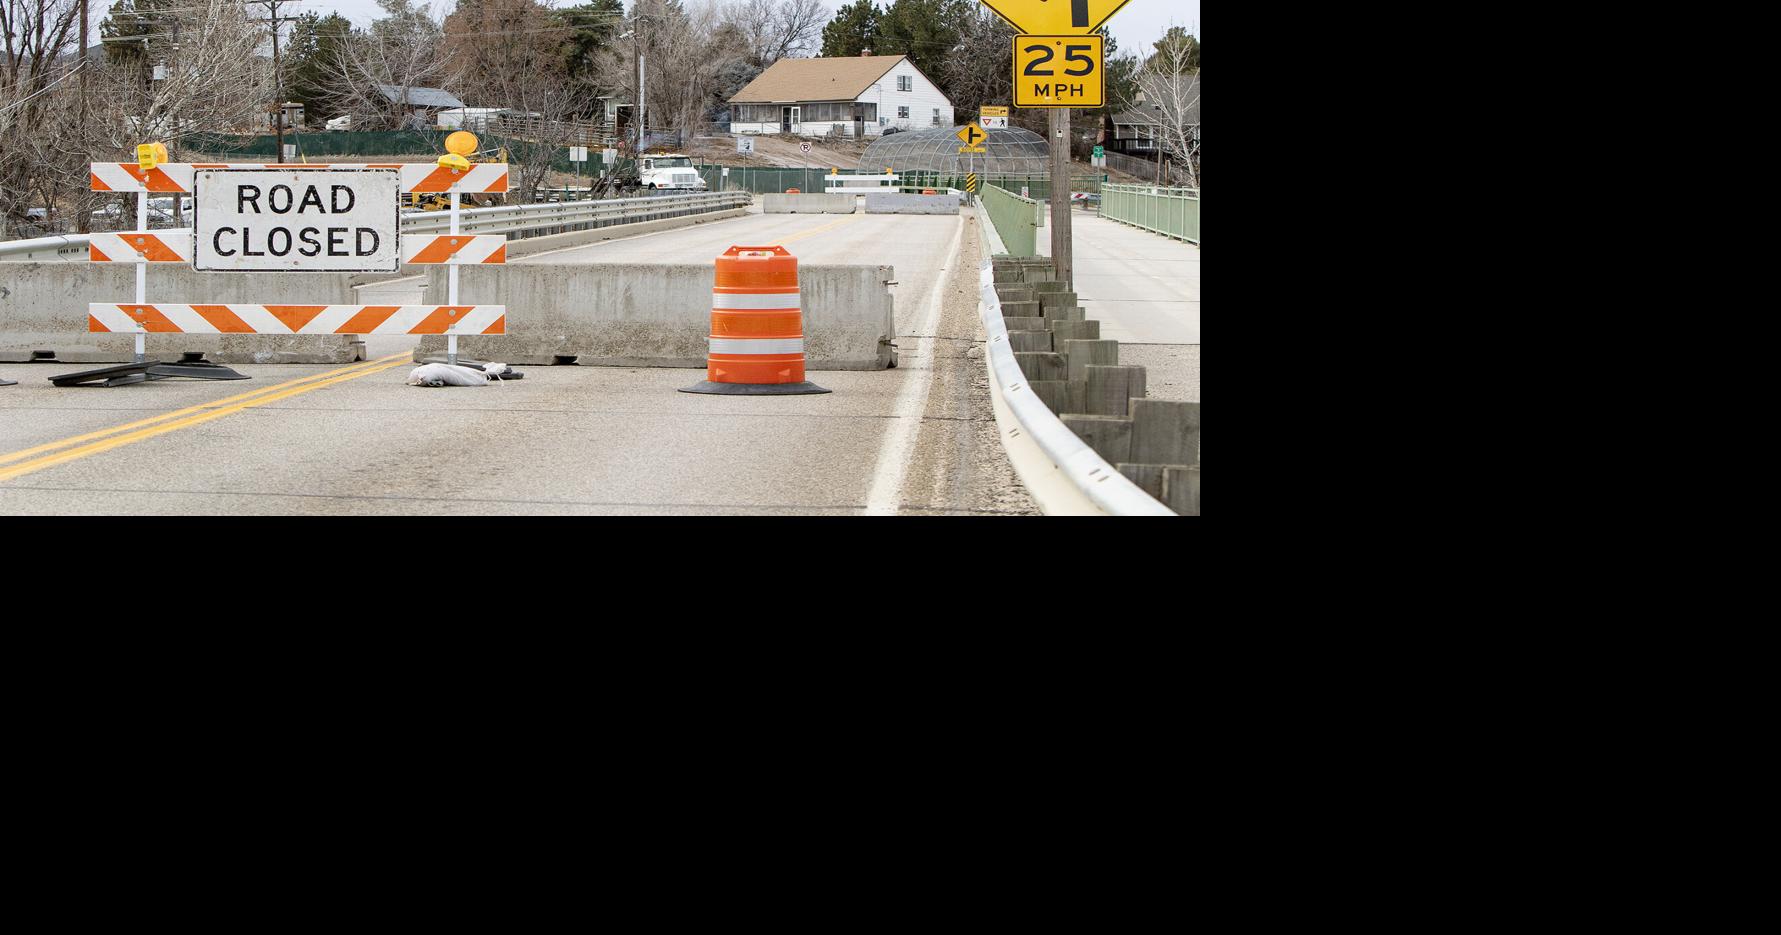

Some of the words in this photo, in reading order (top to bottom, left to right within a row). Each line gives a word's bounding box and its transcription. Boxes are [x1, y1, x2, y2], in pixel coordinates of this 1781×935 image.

[1023, 45, 1094, 76] 25
[1034, 84, 1083, 97] MPH
[237, 184, 356, 214] ROAD
[213, 226, 380, 257] CLOSED
